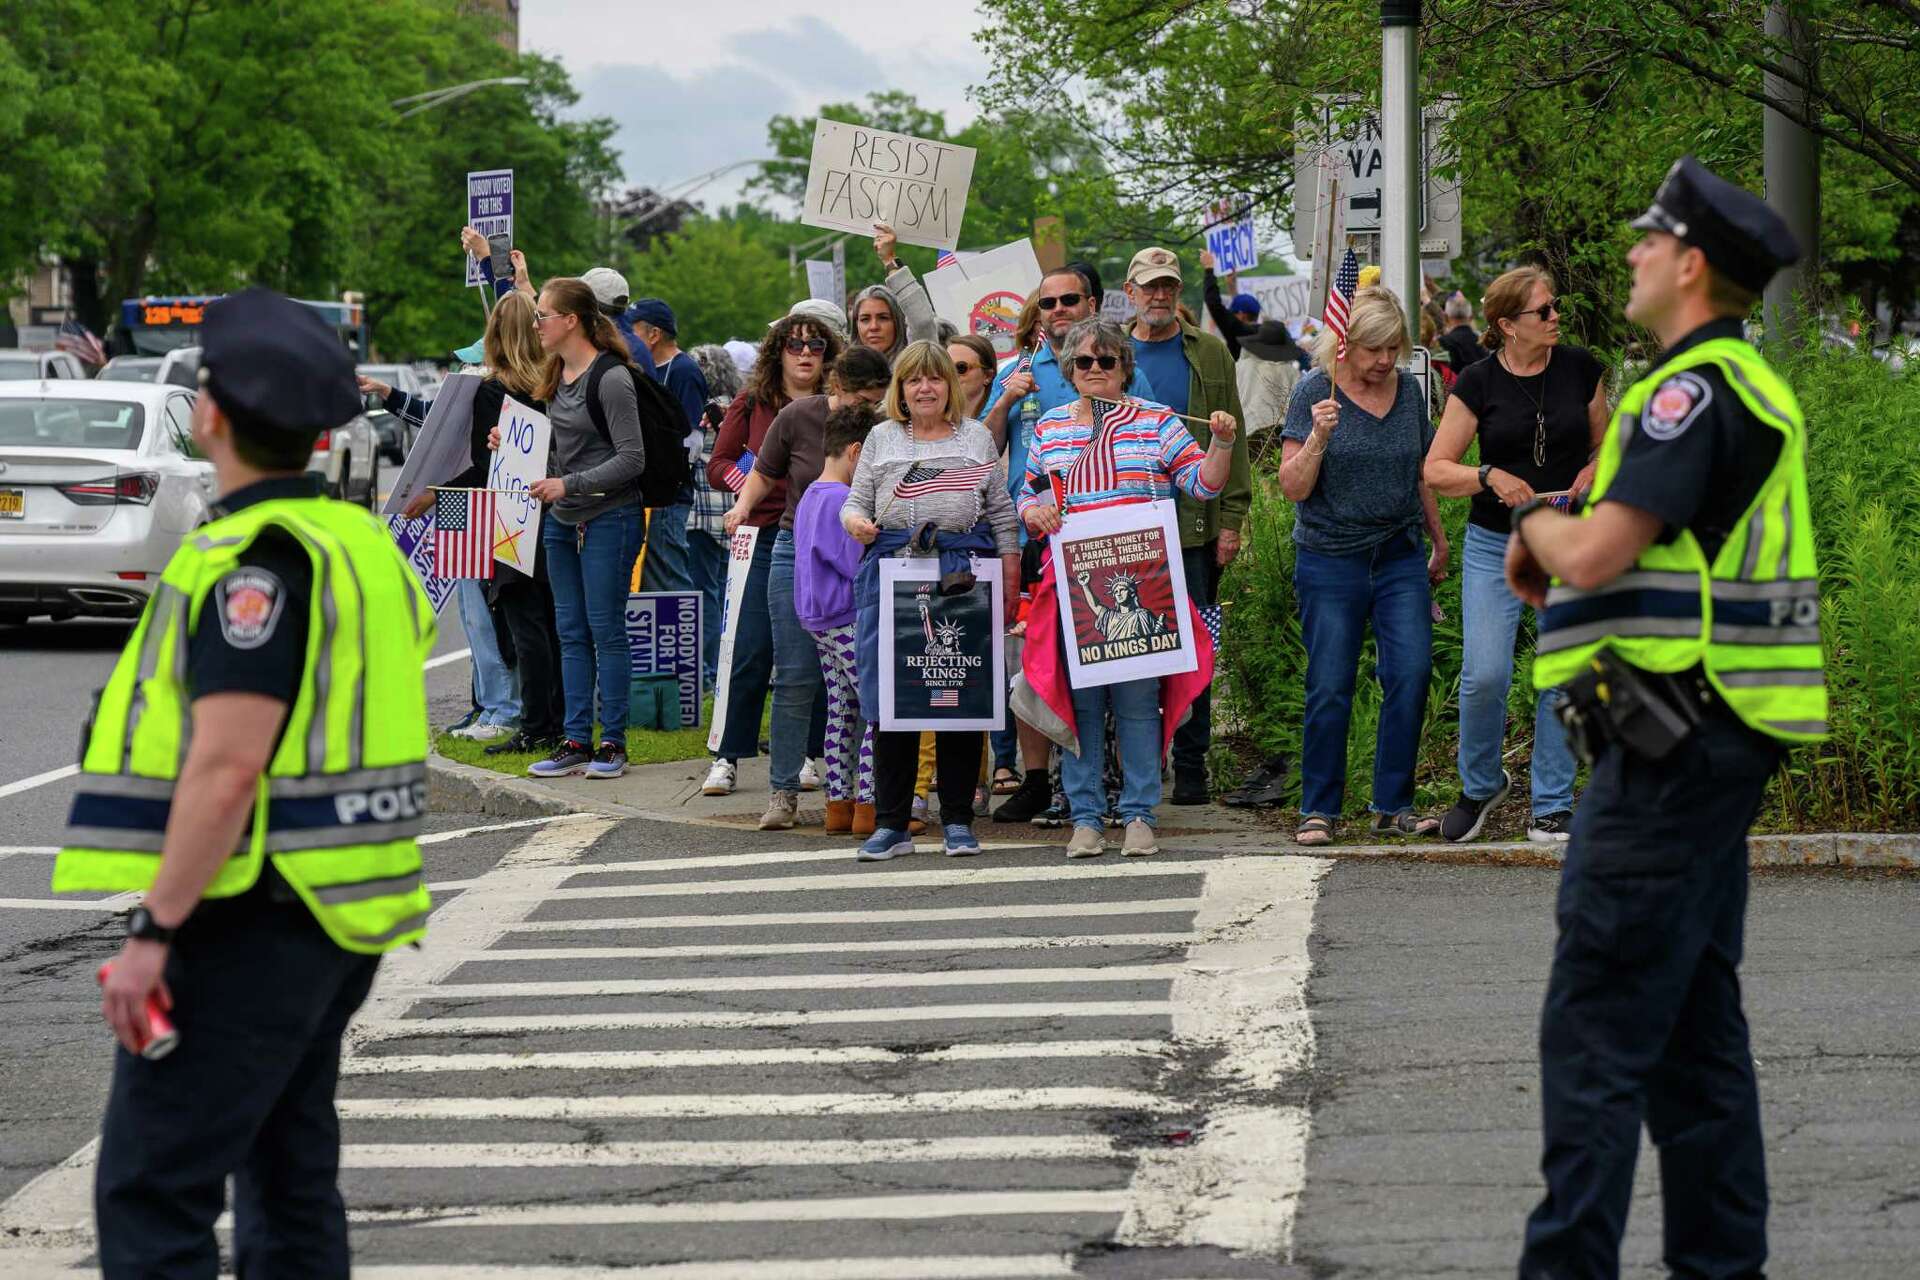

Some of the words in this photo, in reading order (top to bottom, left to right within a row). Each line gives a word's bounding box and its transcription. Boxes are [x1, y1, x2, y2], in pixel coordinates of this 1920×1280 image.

[850, 131, 953, 182] RESIST
[470, 178, 491, 197] NOBODY
[492, 176, 511, 195] VOTED
[478, 198, 489, 215] FOR
[490, 197, 503, 213] THIS
[820, 170, 949, 239] FASCISM
[1209, 220, 1255, 273] MERCY
[507, 416, 534, 454] NO
[1074, 553, 1080, 563] A
[1118, 542, 1151, 556] THERE'S
[1080, 538, 1113, 552] THERE'S
[1114, 533, 1142, 545] MONEY
[1144, 531, 1161, 541] FOR
[1072, 561, 1100, 572] MONEY
[1102, 557, 1118, 567] FOR
[658, 624, 676, 659] FOR
[678, 598, 696, 668] NOBODY
[1080, 646, 1101, 663] NO
[1104, 638, 1148, 659] KINGS
[1151, 633, 1179, 651] DAY
[906, 655, 982, 668] REJECTING
[922, 668, 967, 679] KINGS
[679, 671, 696, 726] VOTED
